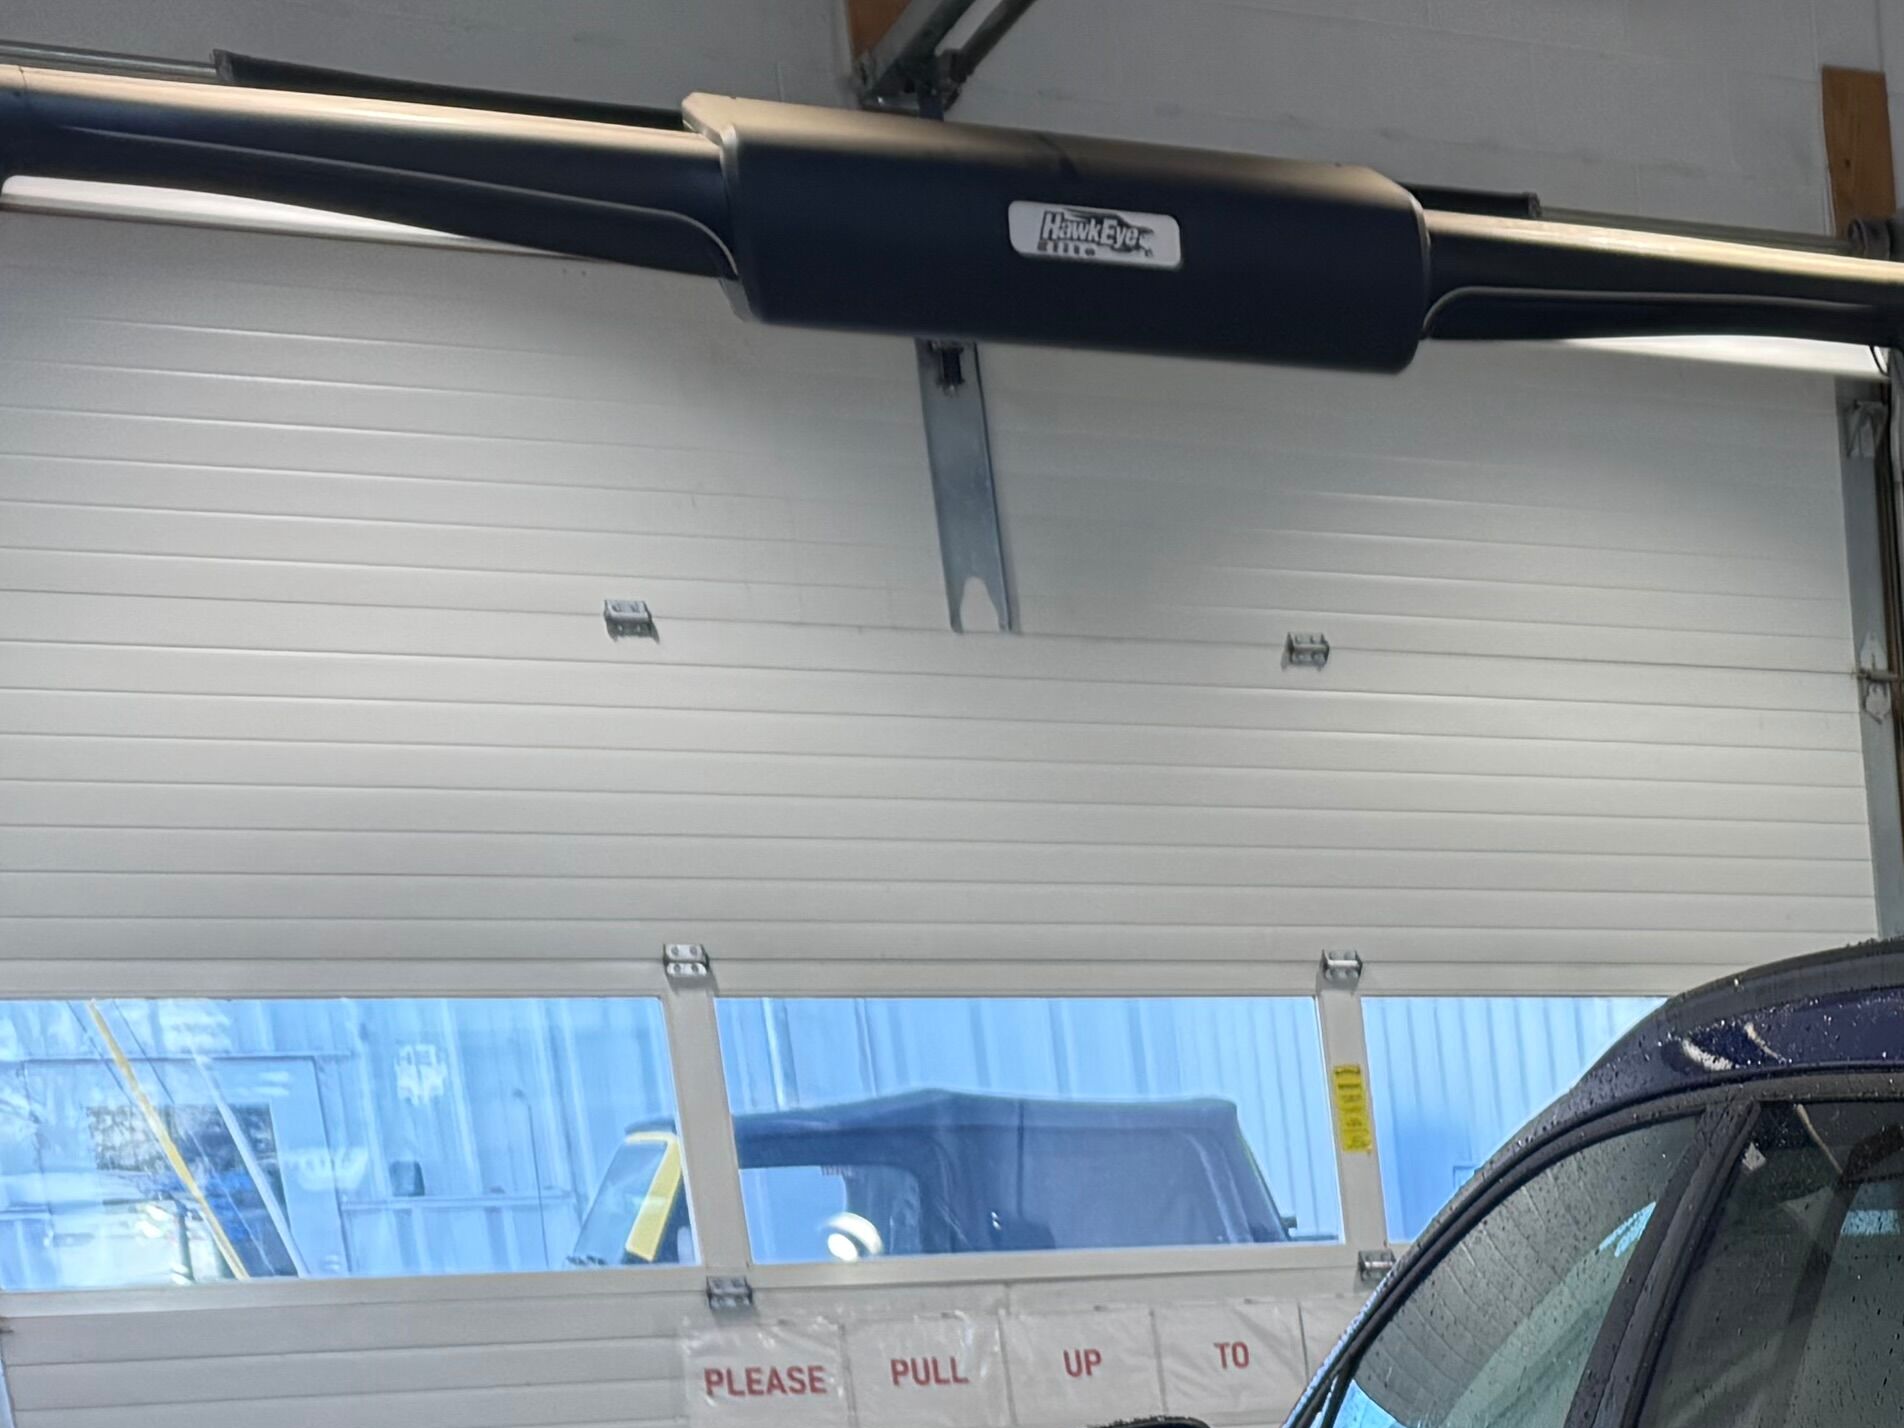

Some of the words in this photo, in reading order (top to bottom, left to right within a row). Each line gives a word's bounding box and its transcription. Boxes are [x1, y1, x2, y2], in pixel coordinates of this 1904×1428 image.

[1040, 210, 1139, 249] HawkEye
[703, 1365, 828, 1397] PLEASE
[890, 1356, 970, 1387] PULL
[1063, 1348, 1102, 1377] UP
[1213, 1341, 1250, 1370] TO
